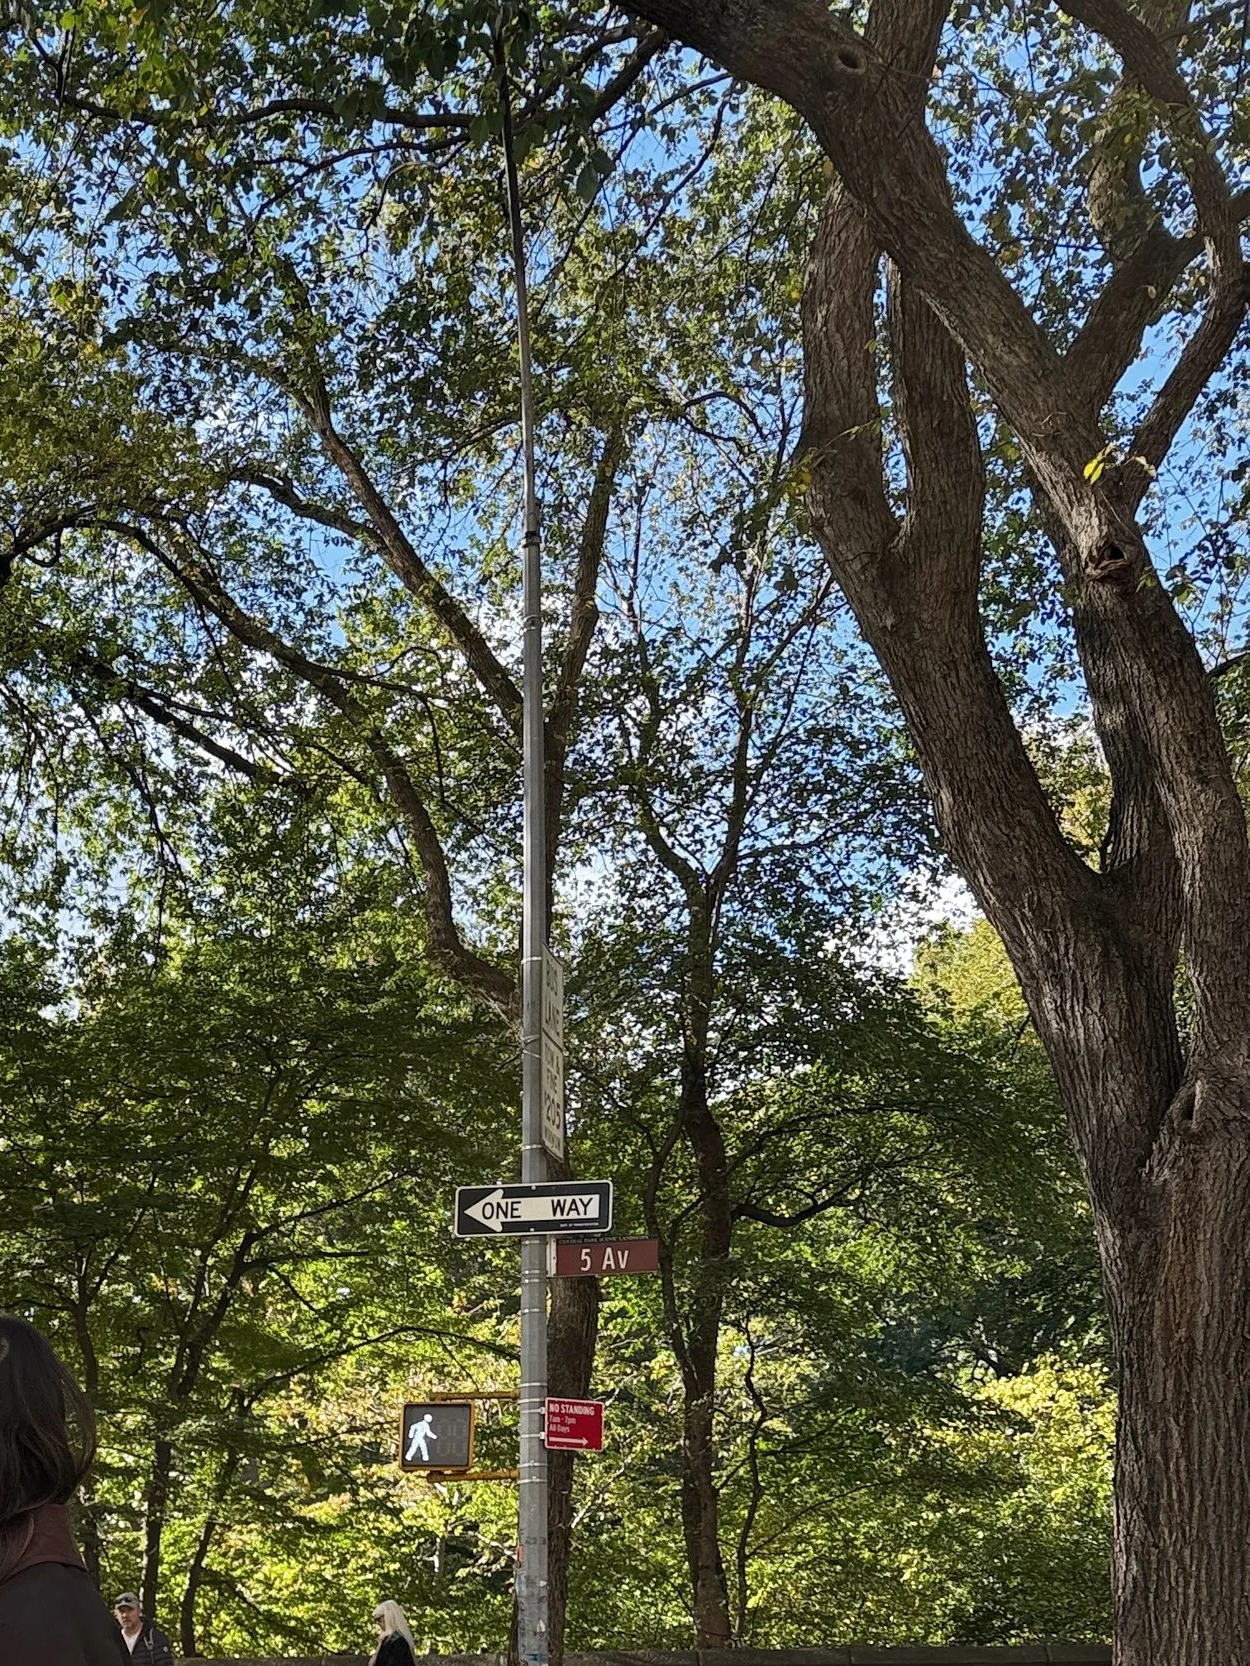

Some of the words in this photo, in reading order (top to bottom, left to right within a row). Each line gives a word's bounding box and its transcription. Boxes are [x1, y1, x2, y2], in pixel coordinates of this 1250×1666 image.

[482, 1201, 522, 1220] ONE
[551, 1197, 594, 1218] WAY
[580, 1248, 592, 1272] 5
[602, 1247, 629, 1270] Av
[549, 1403, 560, 1413] NO
[561, 1404, 595, 1416] STANDING
